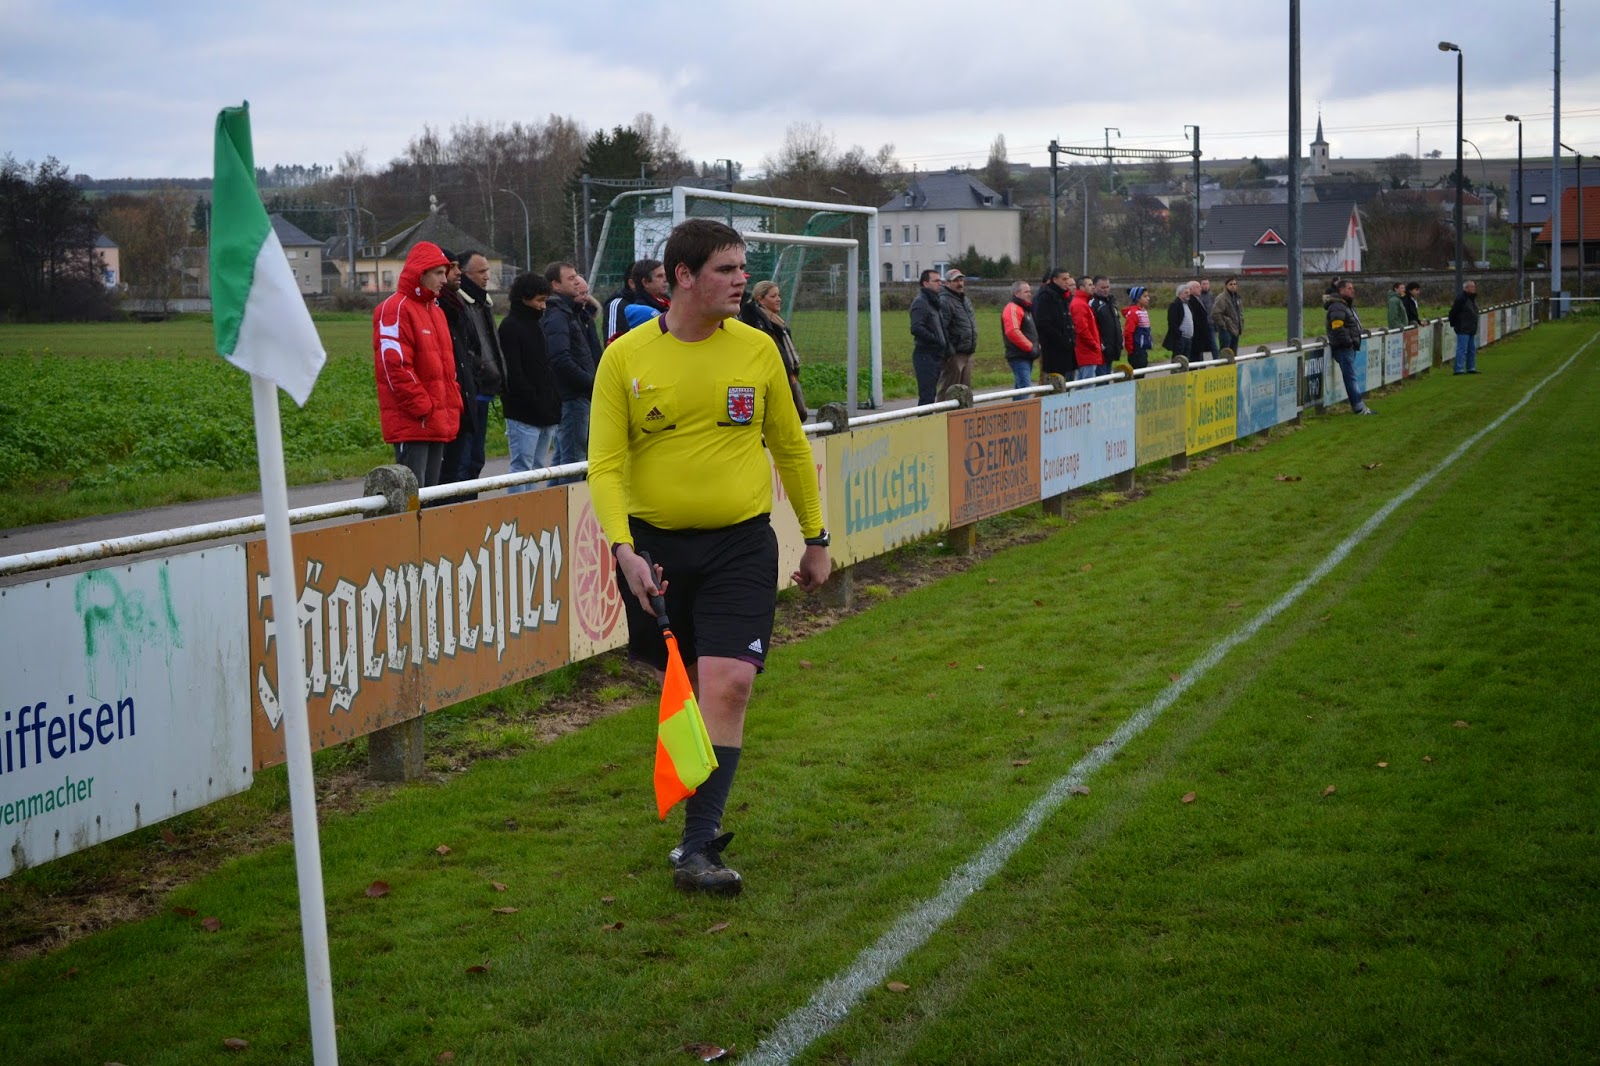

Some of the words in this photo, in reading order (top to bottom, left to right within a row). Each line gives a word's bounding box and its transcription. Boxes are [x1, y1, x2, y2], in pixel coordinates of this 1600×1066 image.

[963, 409, 1028, 440] TELEDISTRIBUTION
[987, 434, 1028, 471] ELTRONA
[845, 453, 931, 536] HILGER
[964, 471, 1019, 502] INTERDIFFUSION
[0, 694, 136, 776] iffeisen
